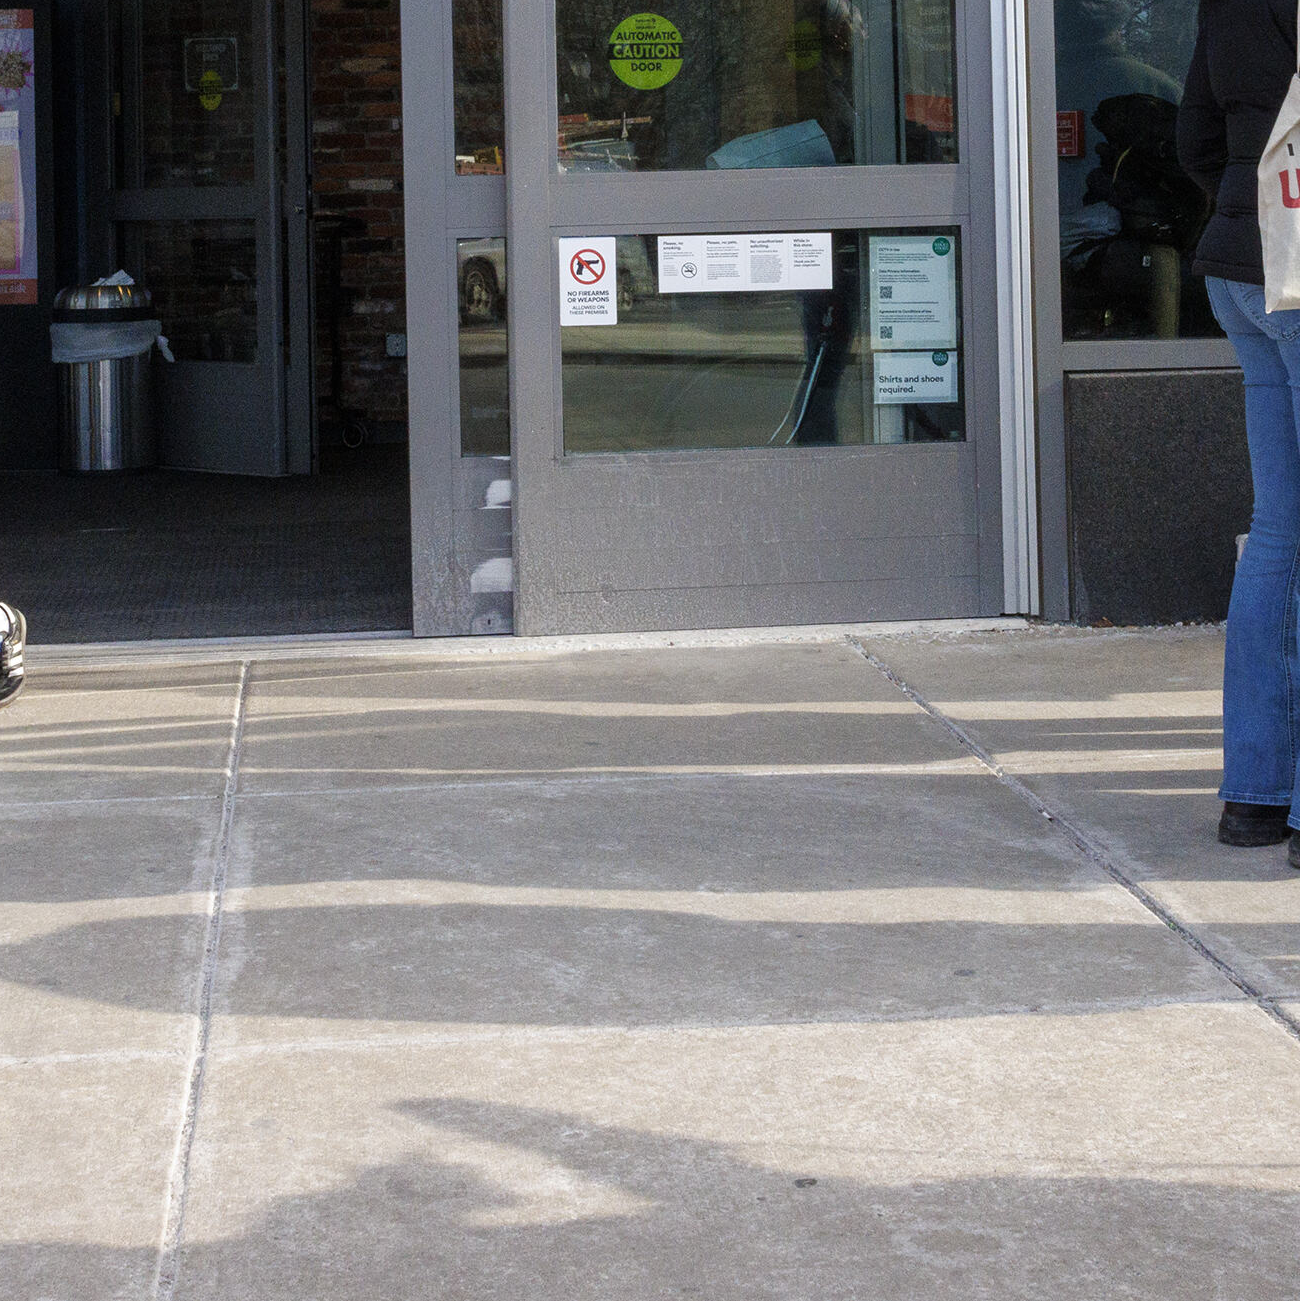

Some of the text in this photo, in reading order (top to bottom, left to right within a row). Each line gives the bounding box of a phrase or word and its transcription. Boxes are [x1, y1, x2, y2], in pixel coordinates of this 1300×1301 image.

[616, 31, 676, 40] AUTOMATIC
[613, 45, 679, 58] CAUTION
[631, 63, 662, 71] DOOR
[879, 386, 916, 394] required.
